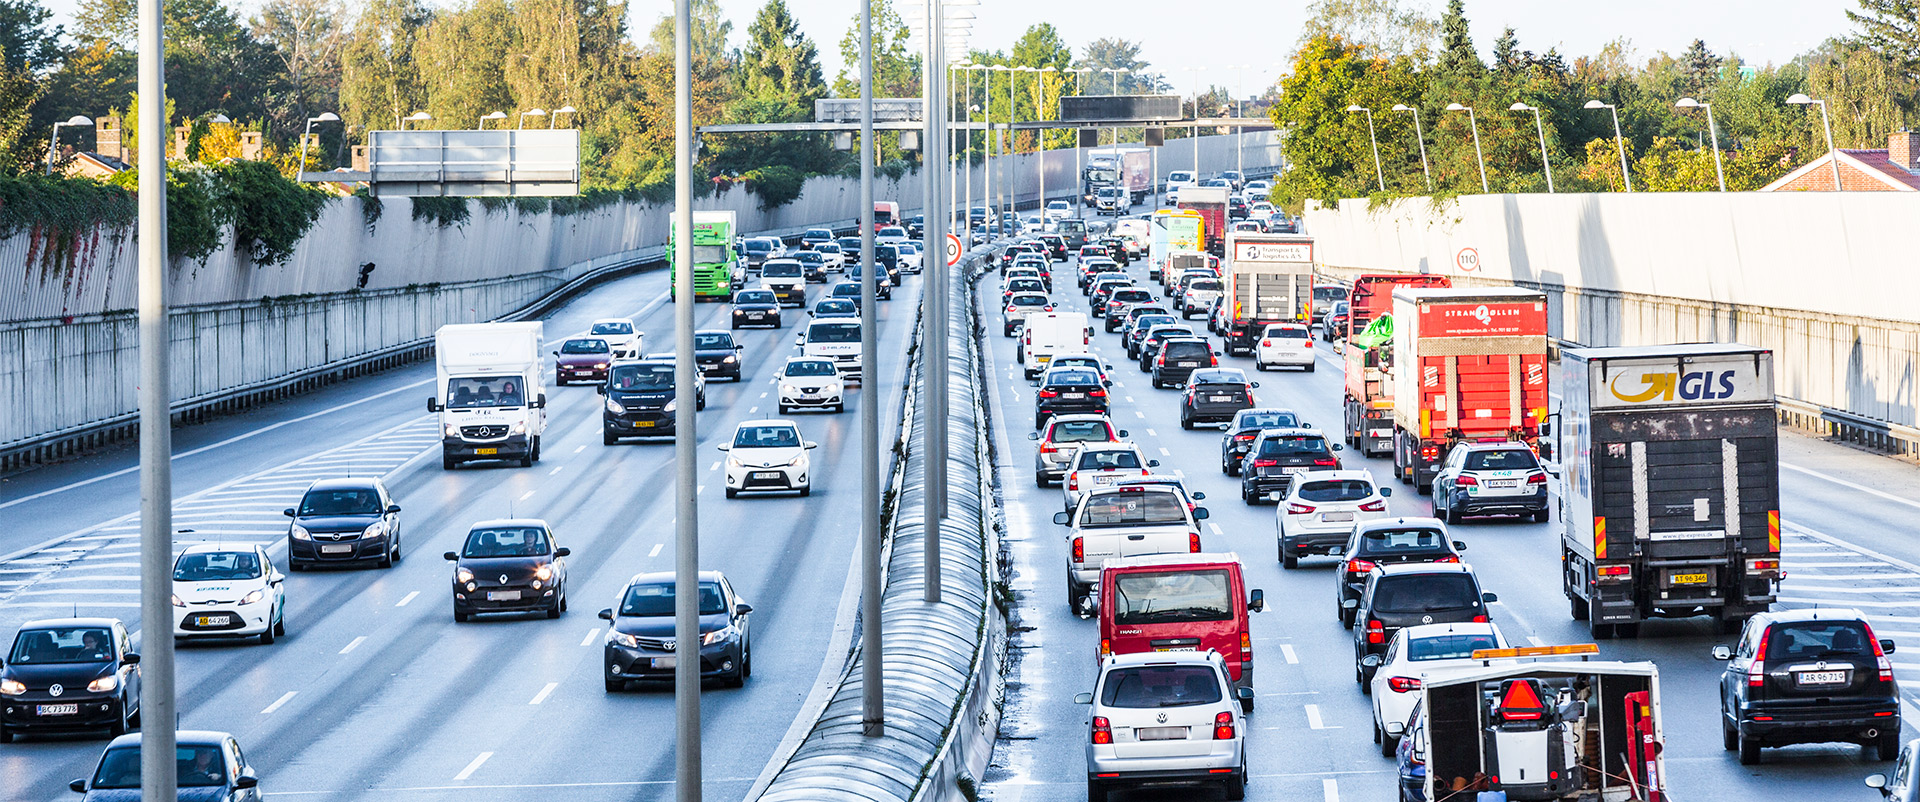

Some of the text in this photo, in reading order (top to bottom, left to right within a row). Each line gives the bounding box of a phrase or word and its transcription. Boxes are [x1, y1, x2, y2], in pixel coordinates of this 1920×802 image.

[1461, 255, 1476, 264] 110
[1678, 370, 1735, 400] GLS
[1662, 531, 1713, 540] www.gls-express.dk
[1805, 672, 1844, 682] AR 96 719
[41, 705, 52, 713] BC
[63, 704, 77, 712] 778
